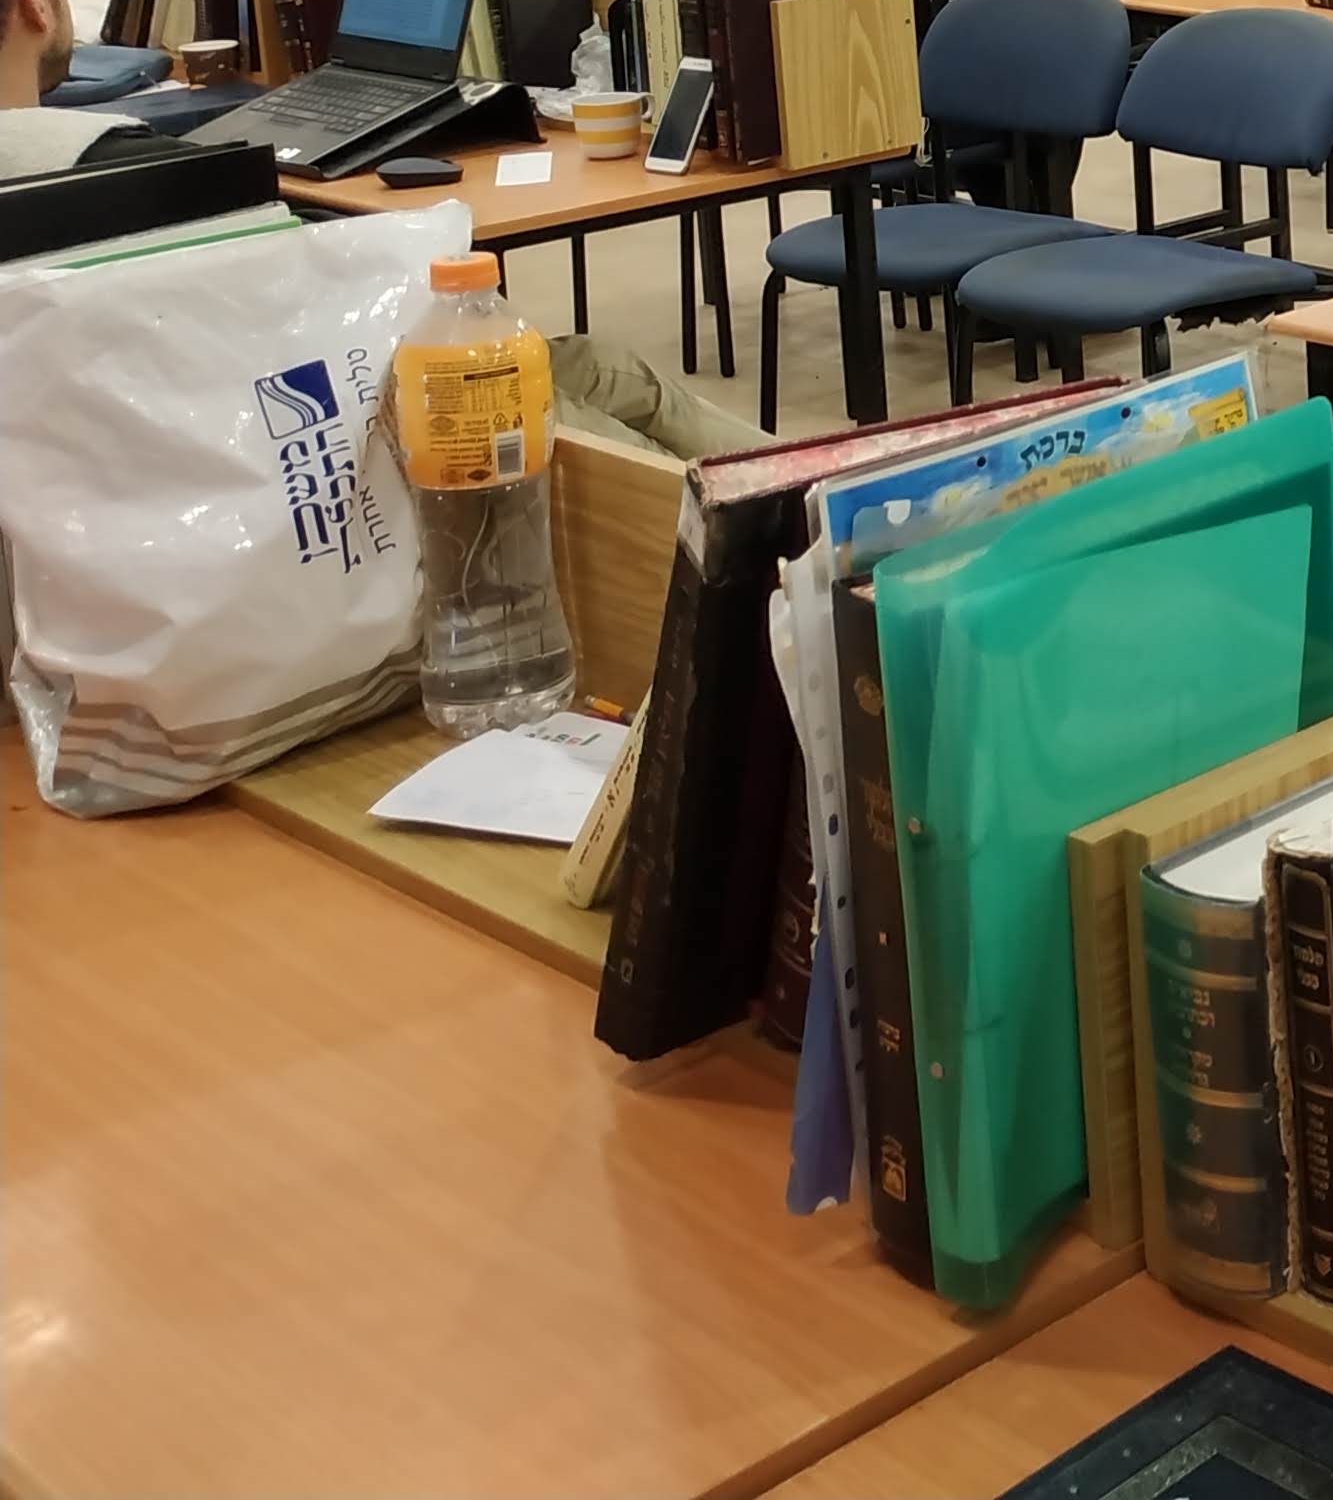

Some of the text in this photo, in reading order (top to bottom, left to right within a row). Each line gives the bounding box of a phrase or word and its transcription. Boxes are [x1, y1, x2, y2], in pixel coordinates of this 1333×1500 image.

[279, 440, 339, 564] משכן
[315, 422, 362, 575] התכלת
[346, 347, 397, 555] טלית אחרת
[1017, 427, 1087, 471] ברכת
